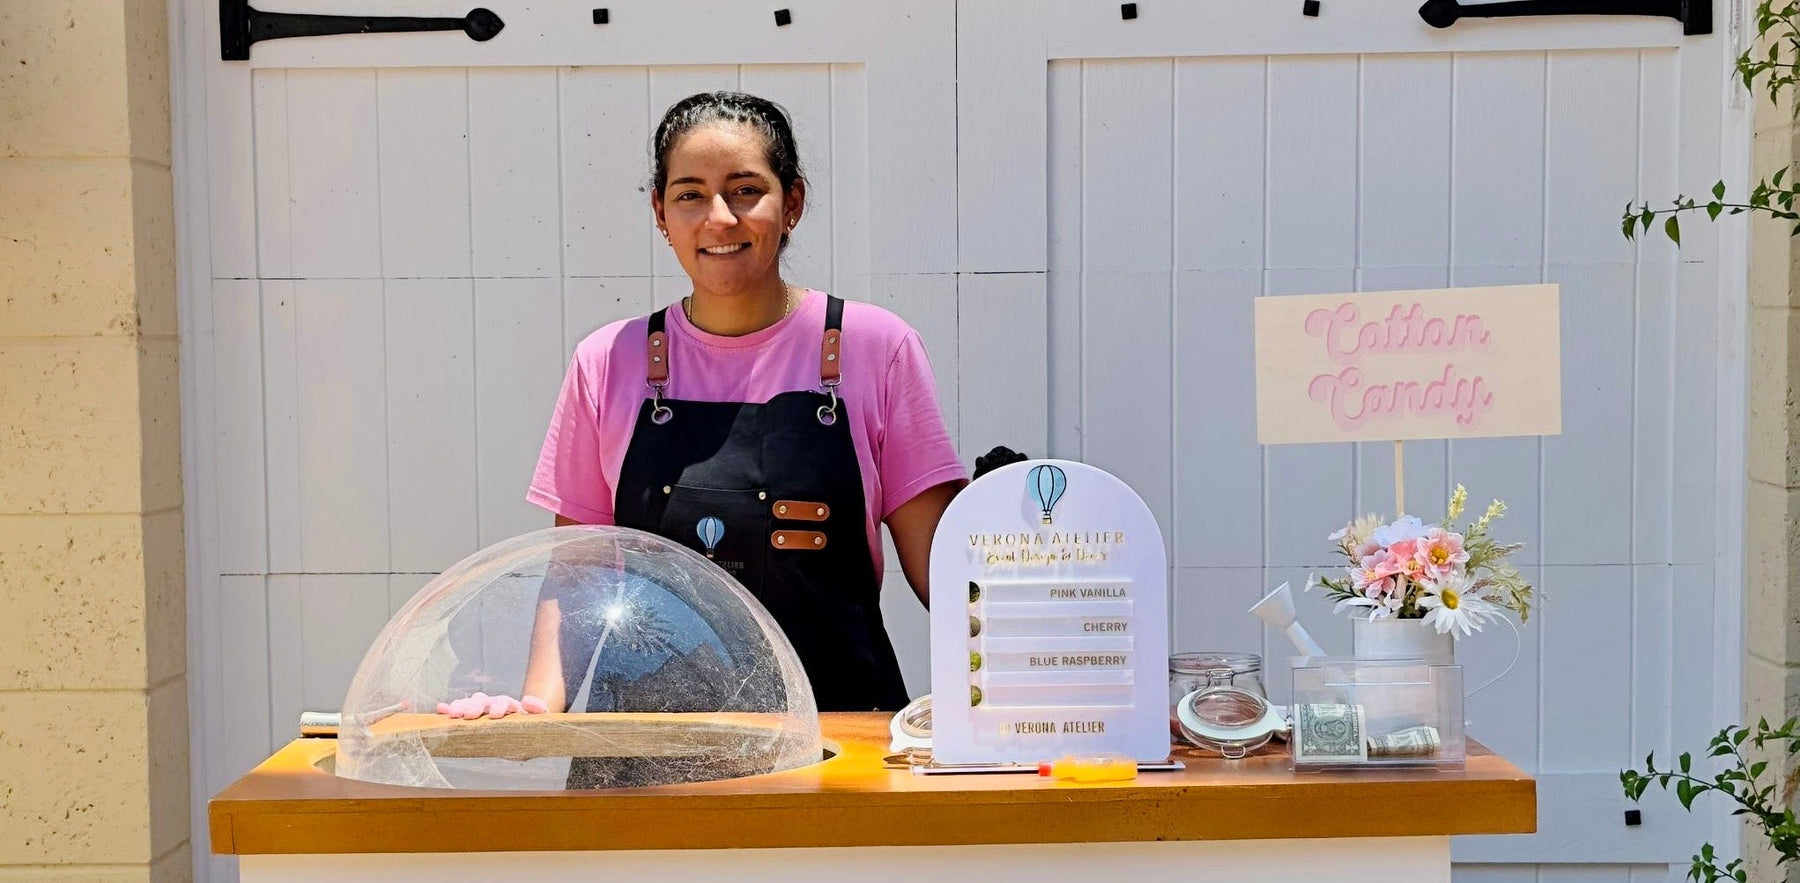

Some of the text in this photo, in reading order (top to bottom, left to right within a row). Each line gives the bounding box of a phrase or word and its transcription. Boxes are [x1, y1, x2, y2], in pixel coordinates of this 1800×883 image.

[1304, 302, 1490, 358] Cotton
[1307, 363, 1496, 429] Candy
[969, 531, 1124, 546] VERONA ATELIER
[1050, 587, 1126, 598] PINK VANILLA
[1083, 622, 1128, 632] CHERRY
[1029, 655, 1127, 666] BLUE RASPBERRY
[1014, 721, 1105, 734] VERONA ATELIER
